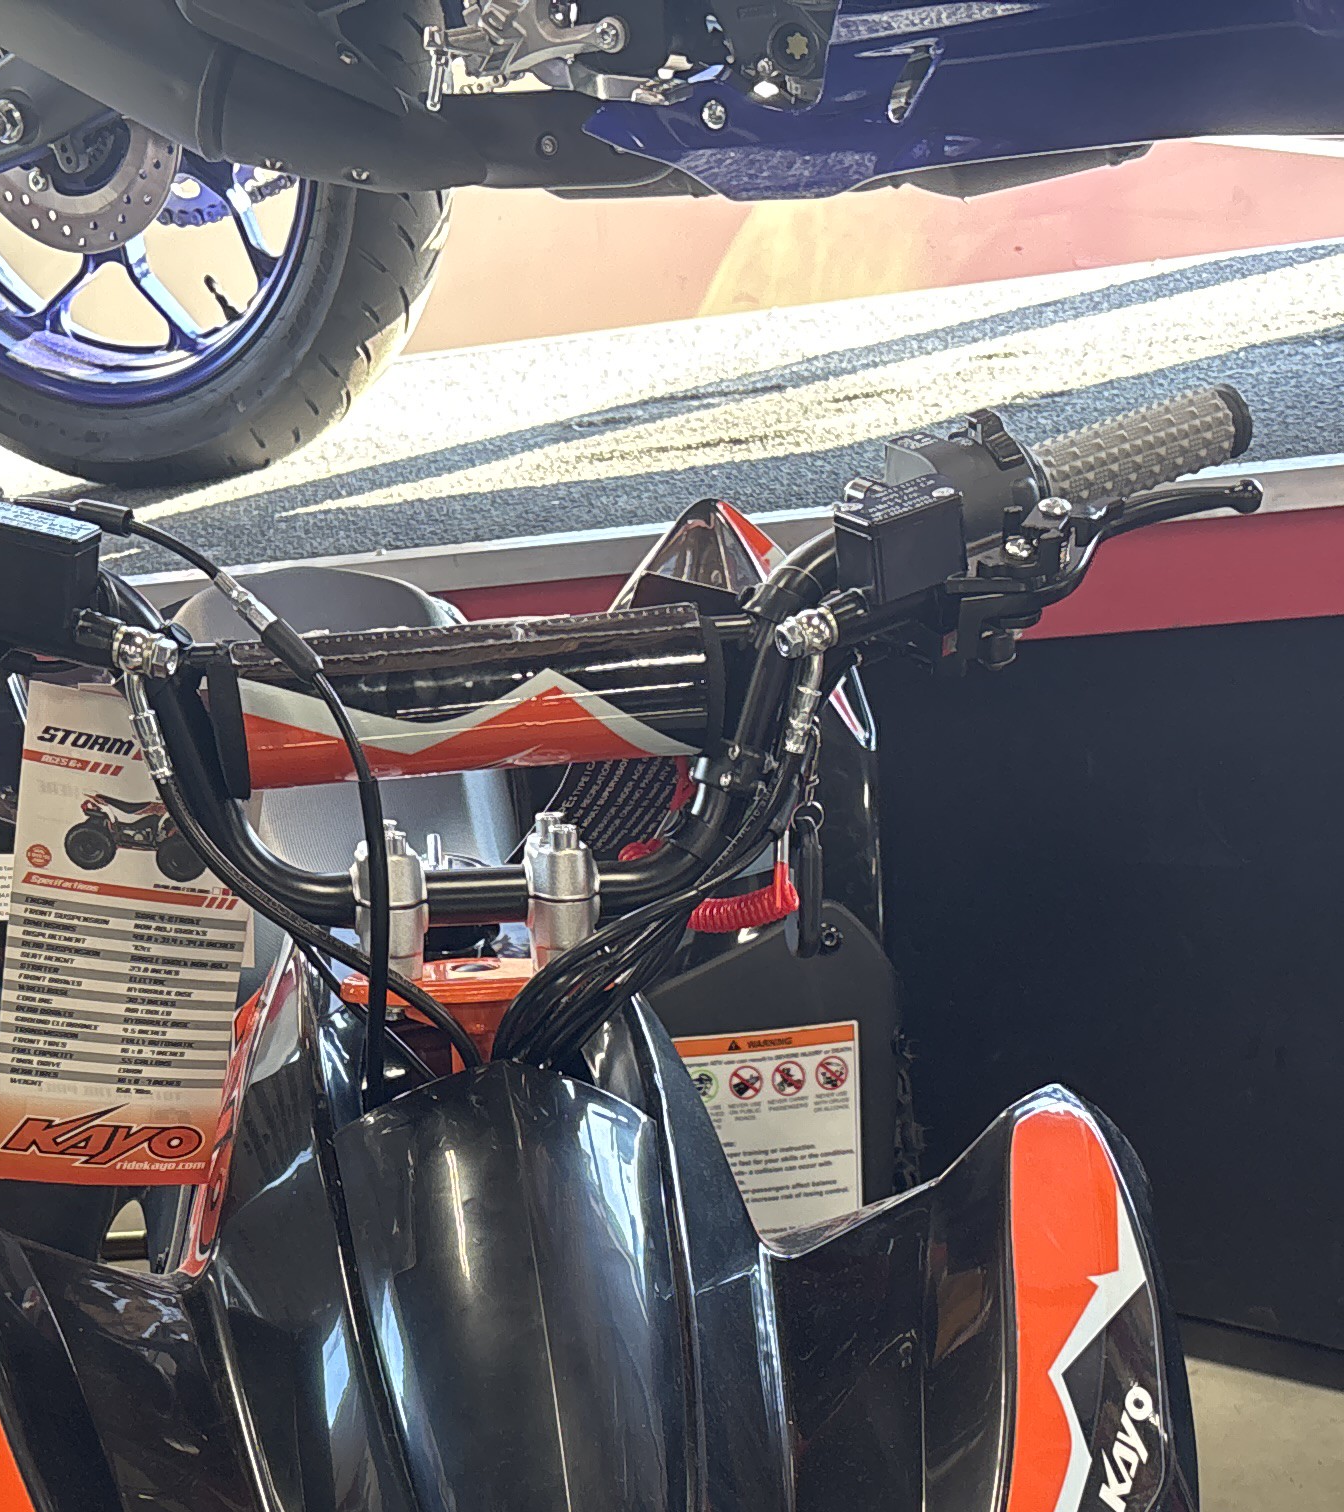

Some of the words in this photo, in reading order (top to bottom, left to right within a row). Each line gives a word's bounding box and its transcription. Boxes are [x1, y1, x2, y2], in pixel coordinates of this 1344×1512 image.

[36, 725, 135, 756] STORM
[40, 755, 69, 766] AGES
[747, 1036, 793, 1049] WARNING
[115, 1160, 206, 1172] ridekayo.com
